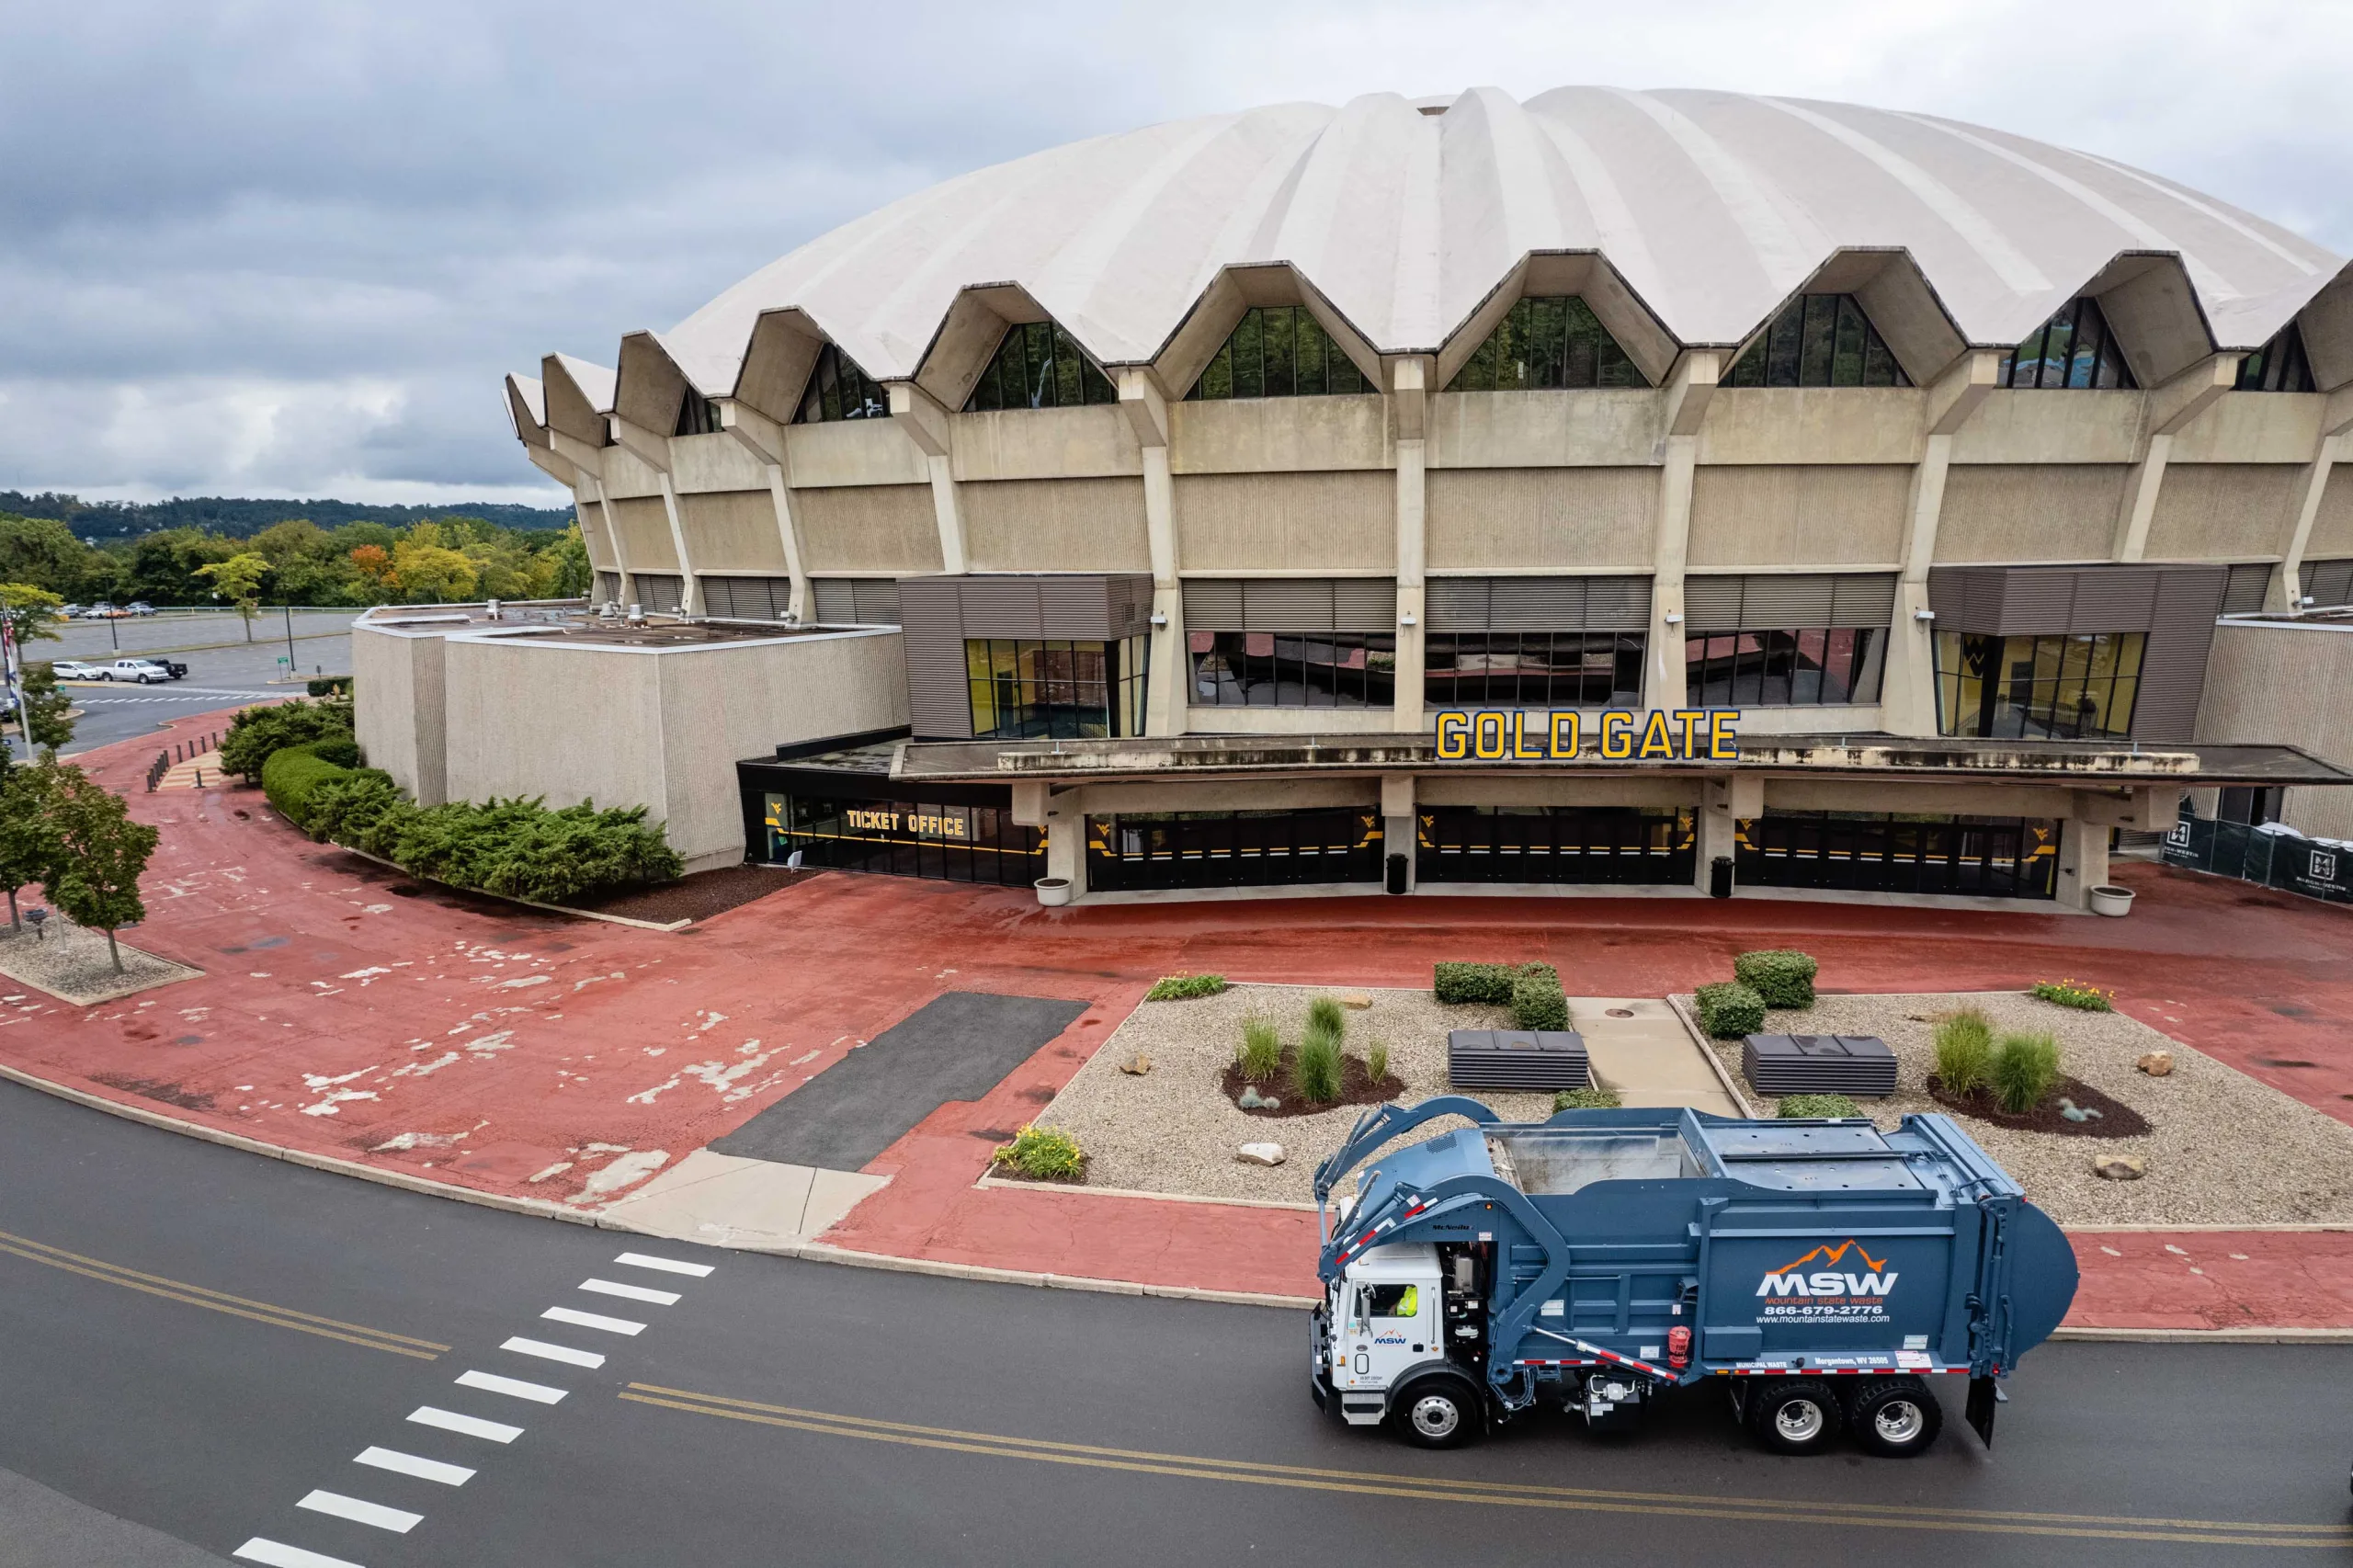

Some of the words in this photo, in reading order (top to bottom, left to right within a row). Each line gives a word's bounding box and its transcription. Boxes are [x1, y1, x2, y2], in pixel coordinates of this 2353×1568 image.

[1435, 710, 1580, 760] GOLD
[1599, 710, 1741, 760] GATE
[847, 810, 900, 831] TICKET
[908, 814, 964, 836] OFFICE
[1756, 1272, 1898, 1296] MSW
[1817, 1296, 1846, 1305] state
[1850, 1296, 1882, 1305] waste
[1764, 1305, 1883, 1315] 866-679-2776
[1756, 1314, 1890, 1324] www.mountainstatewaste.com
[1814, 1357, 1857, 1367] Morgantown,
[1857, 1357, 1867, 1365] WV
